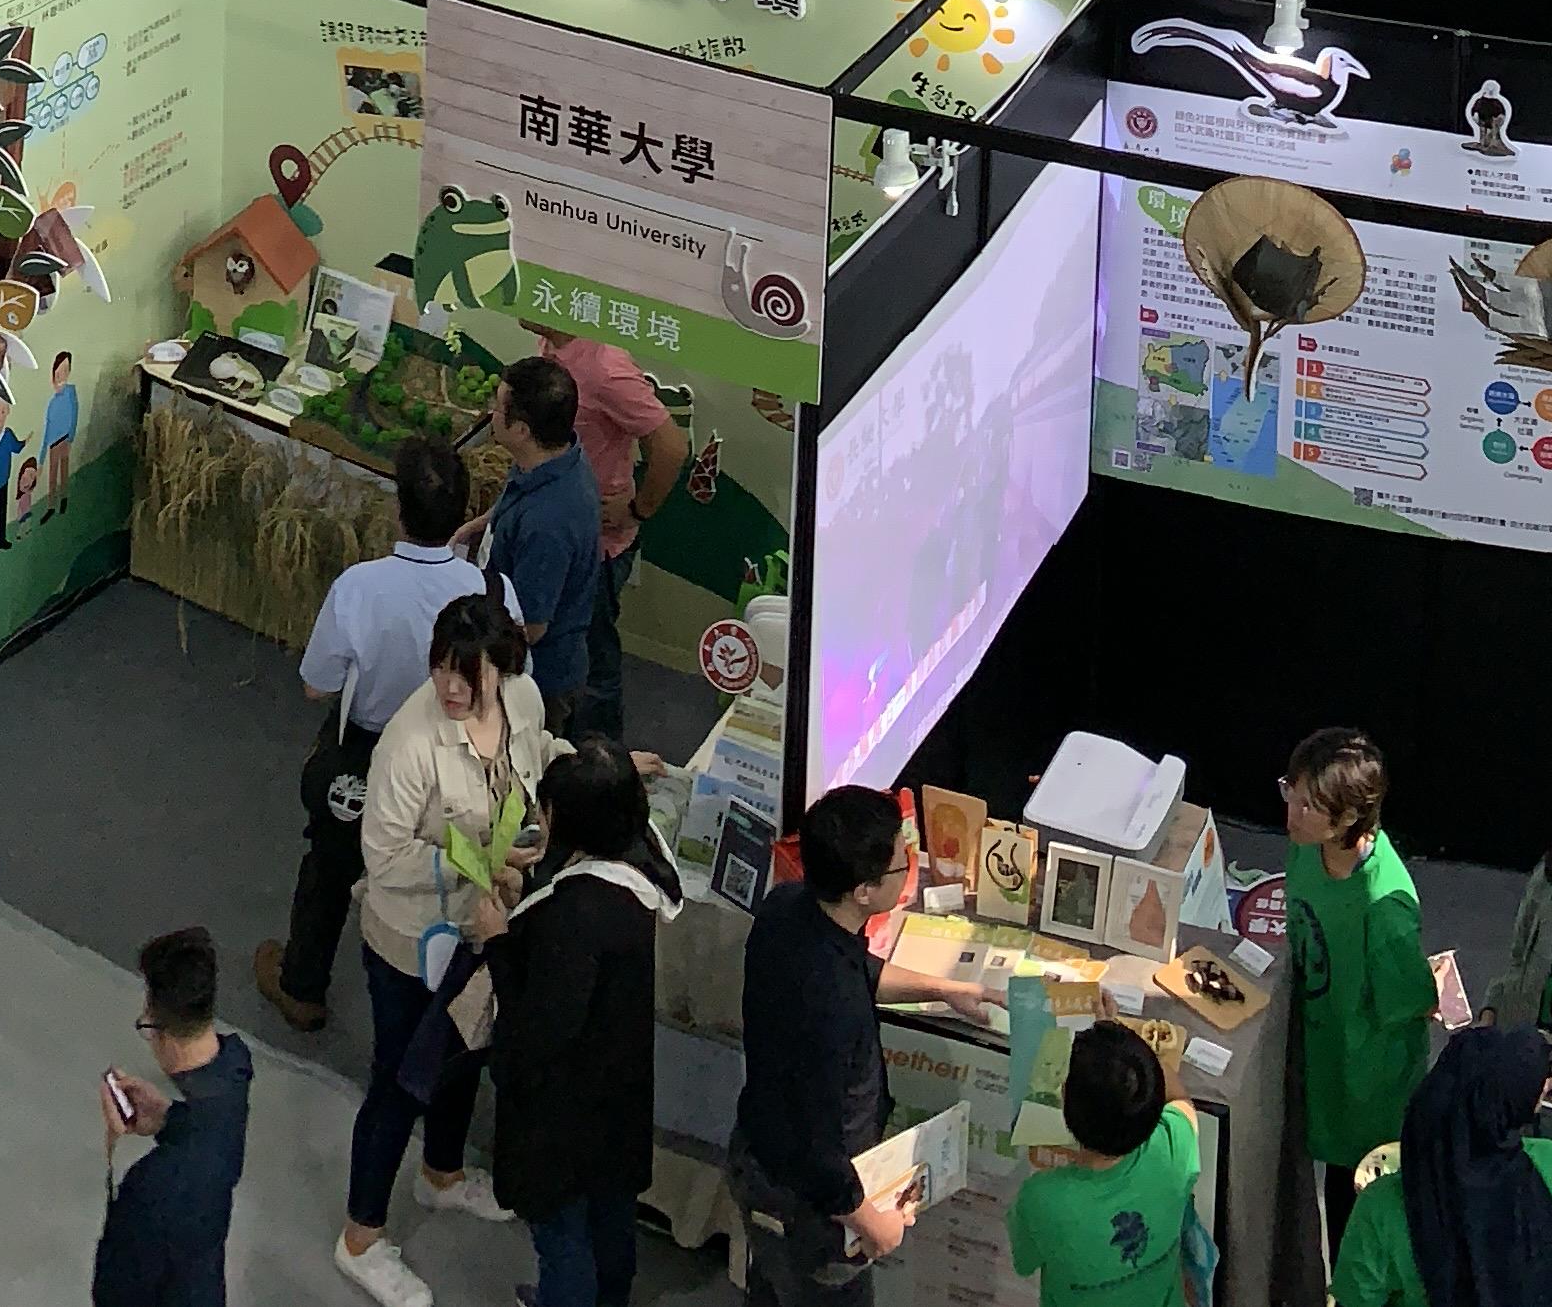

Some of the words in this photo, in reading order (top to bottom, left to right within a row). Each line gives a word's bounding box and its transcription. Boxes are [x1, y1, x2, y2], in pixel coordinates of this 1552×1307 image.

[517, 91, 716, 186] 南華大學
[524, 188, 599, 226] Nanhua
[606, 210, 708, 261] University
[529, 277, 684, 354] 永續環境
